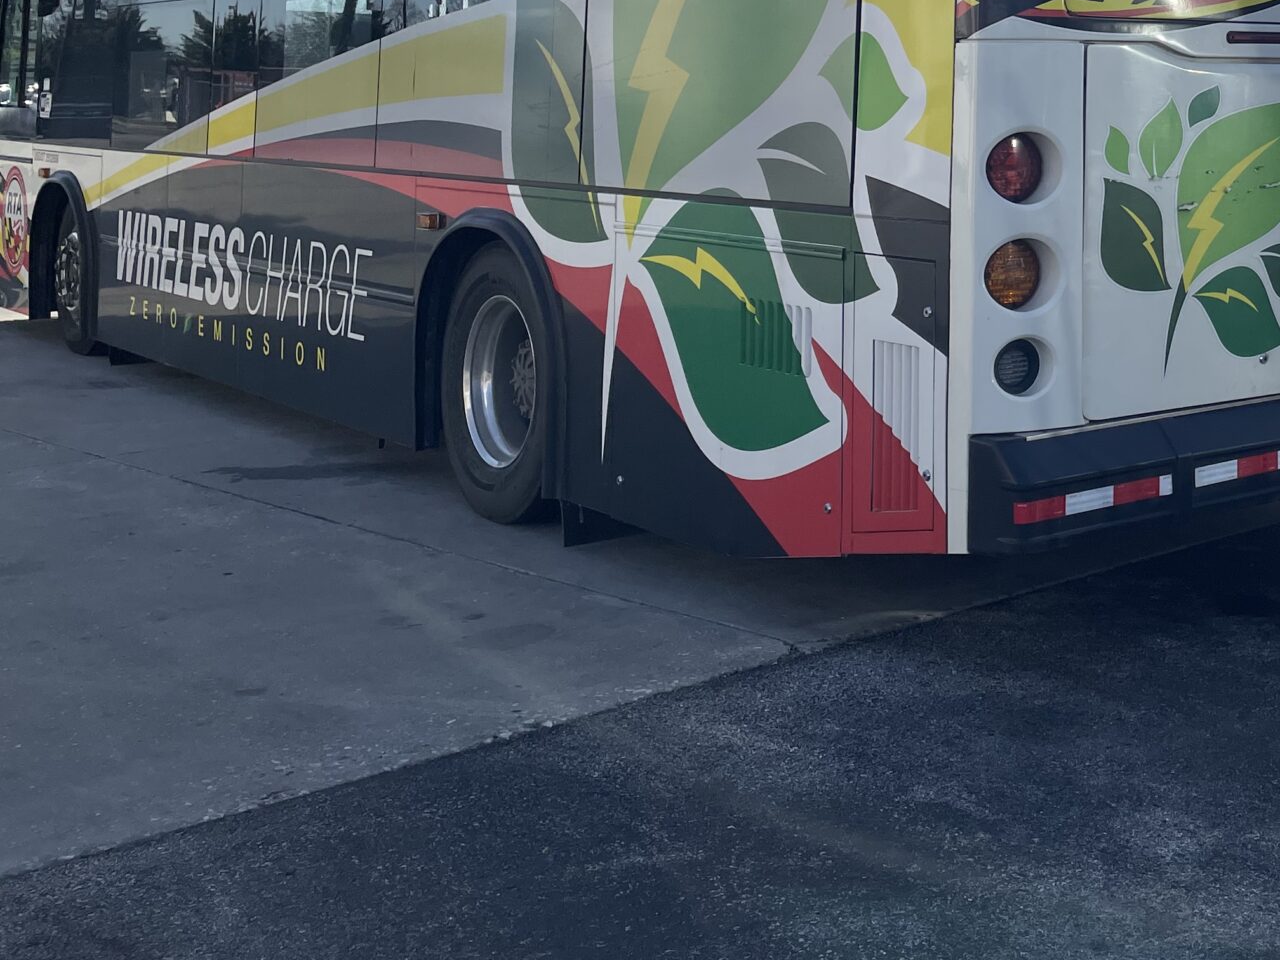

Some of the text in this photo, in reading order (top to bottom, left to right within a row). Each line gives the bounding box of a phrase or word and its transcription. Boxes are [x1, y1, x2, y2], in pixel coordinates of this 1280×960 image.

[6, 191, 22, 215] RTA
[116, 209, 373, 341] WIRELESS CHARGE
[130, 296, 325, 372] ZERO EMISSION
